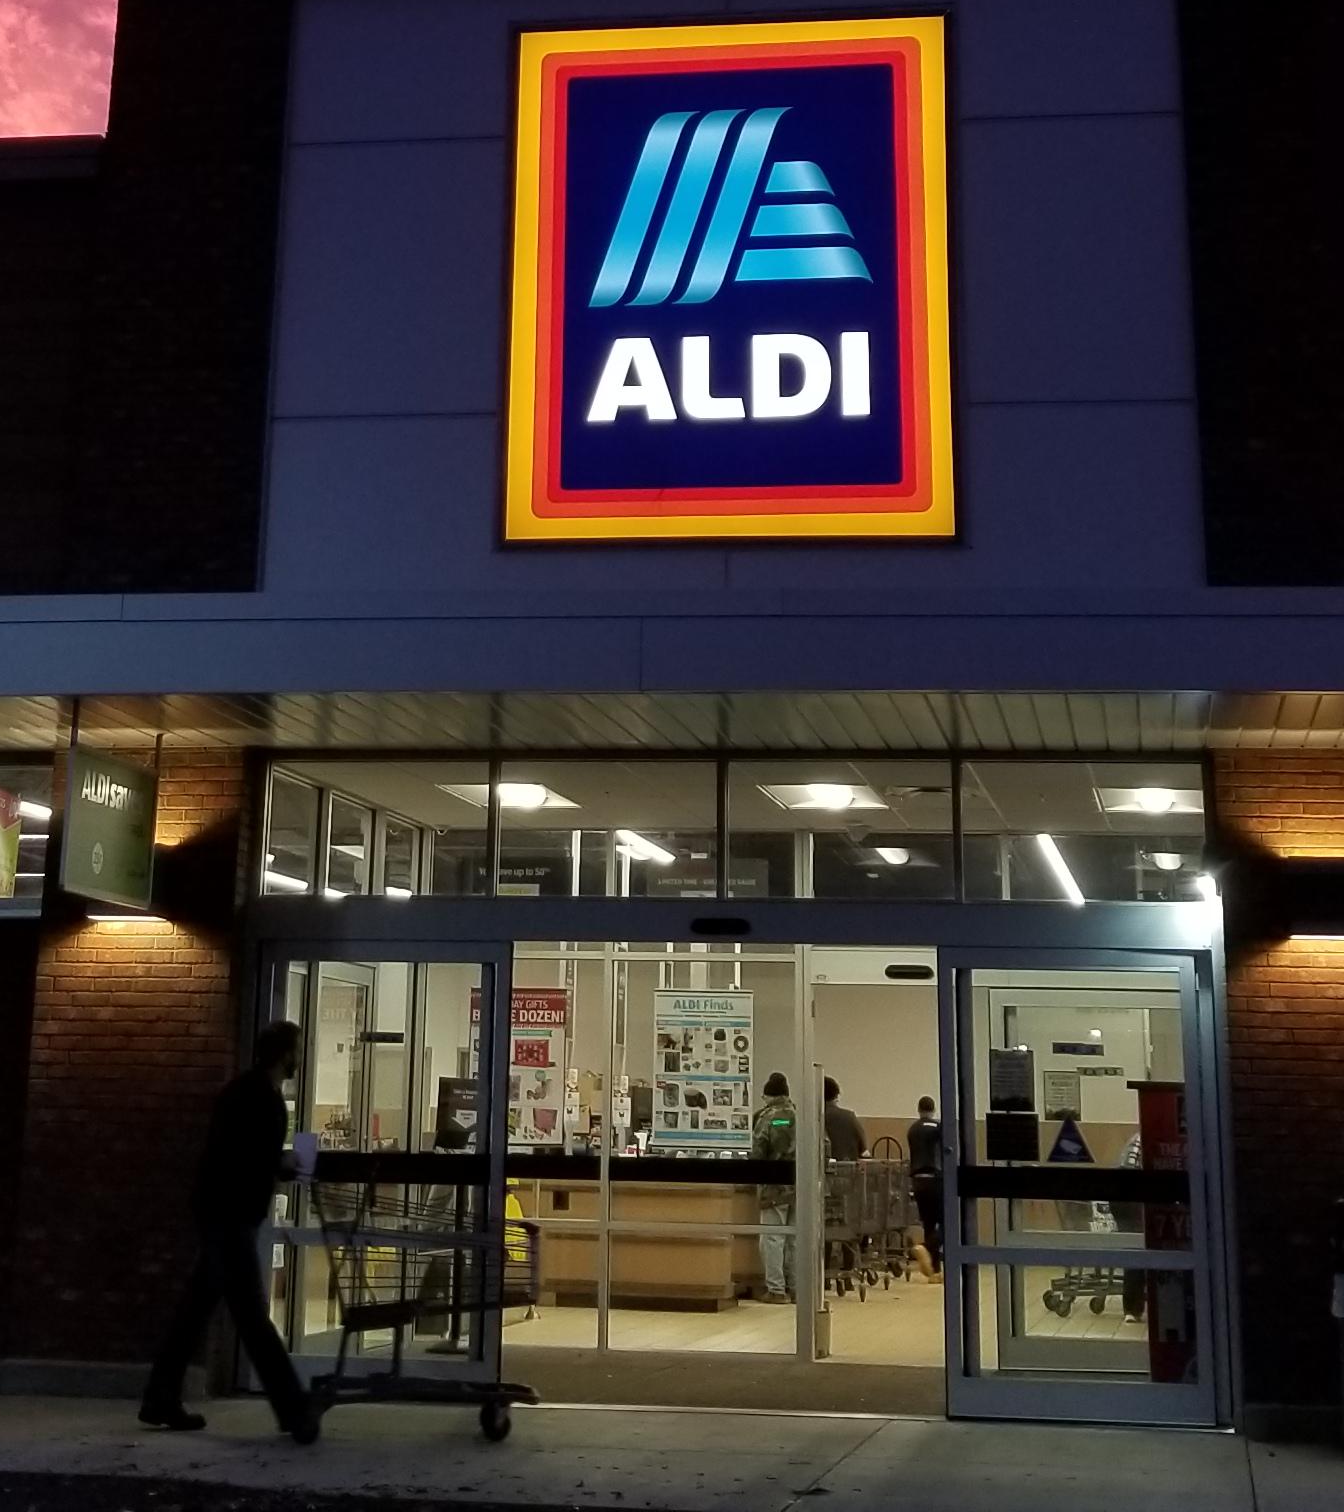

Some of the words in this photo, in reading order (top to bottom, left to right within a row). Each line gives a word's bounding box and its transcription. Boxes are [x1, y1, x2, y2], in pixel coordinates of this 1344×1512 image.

[587, 330, 872, 423] ALDI
[81, 769, 110, 806] ALDI
[109, 783, 142, 812] sav
[673, 999, 699, 1010] ALDI
[703, 999, 734, 1010] Finds
